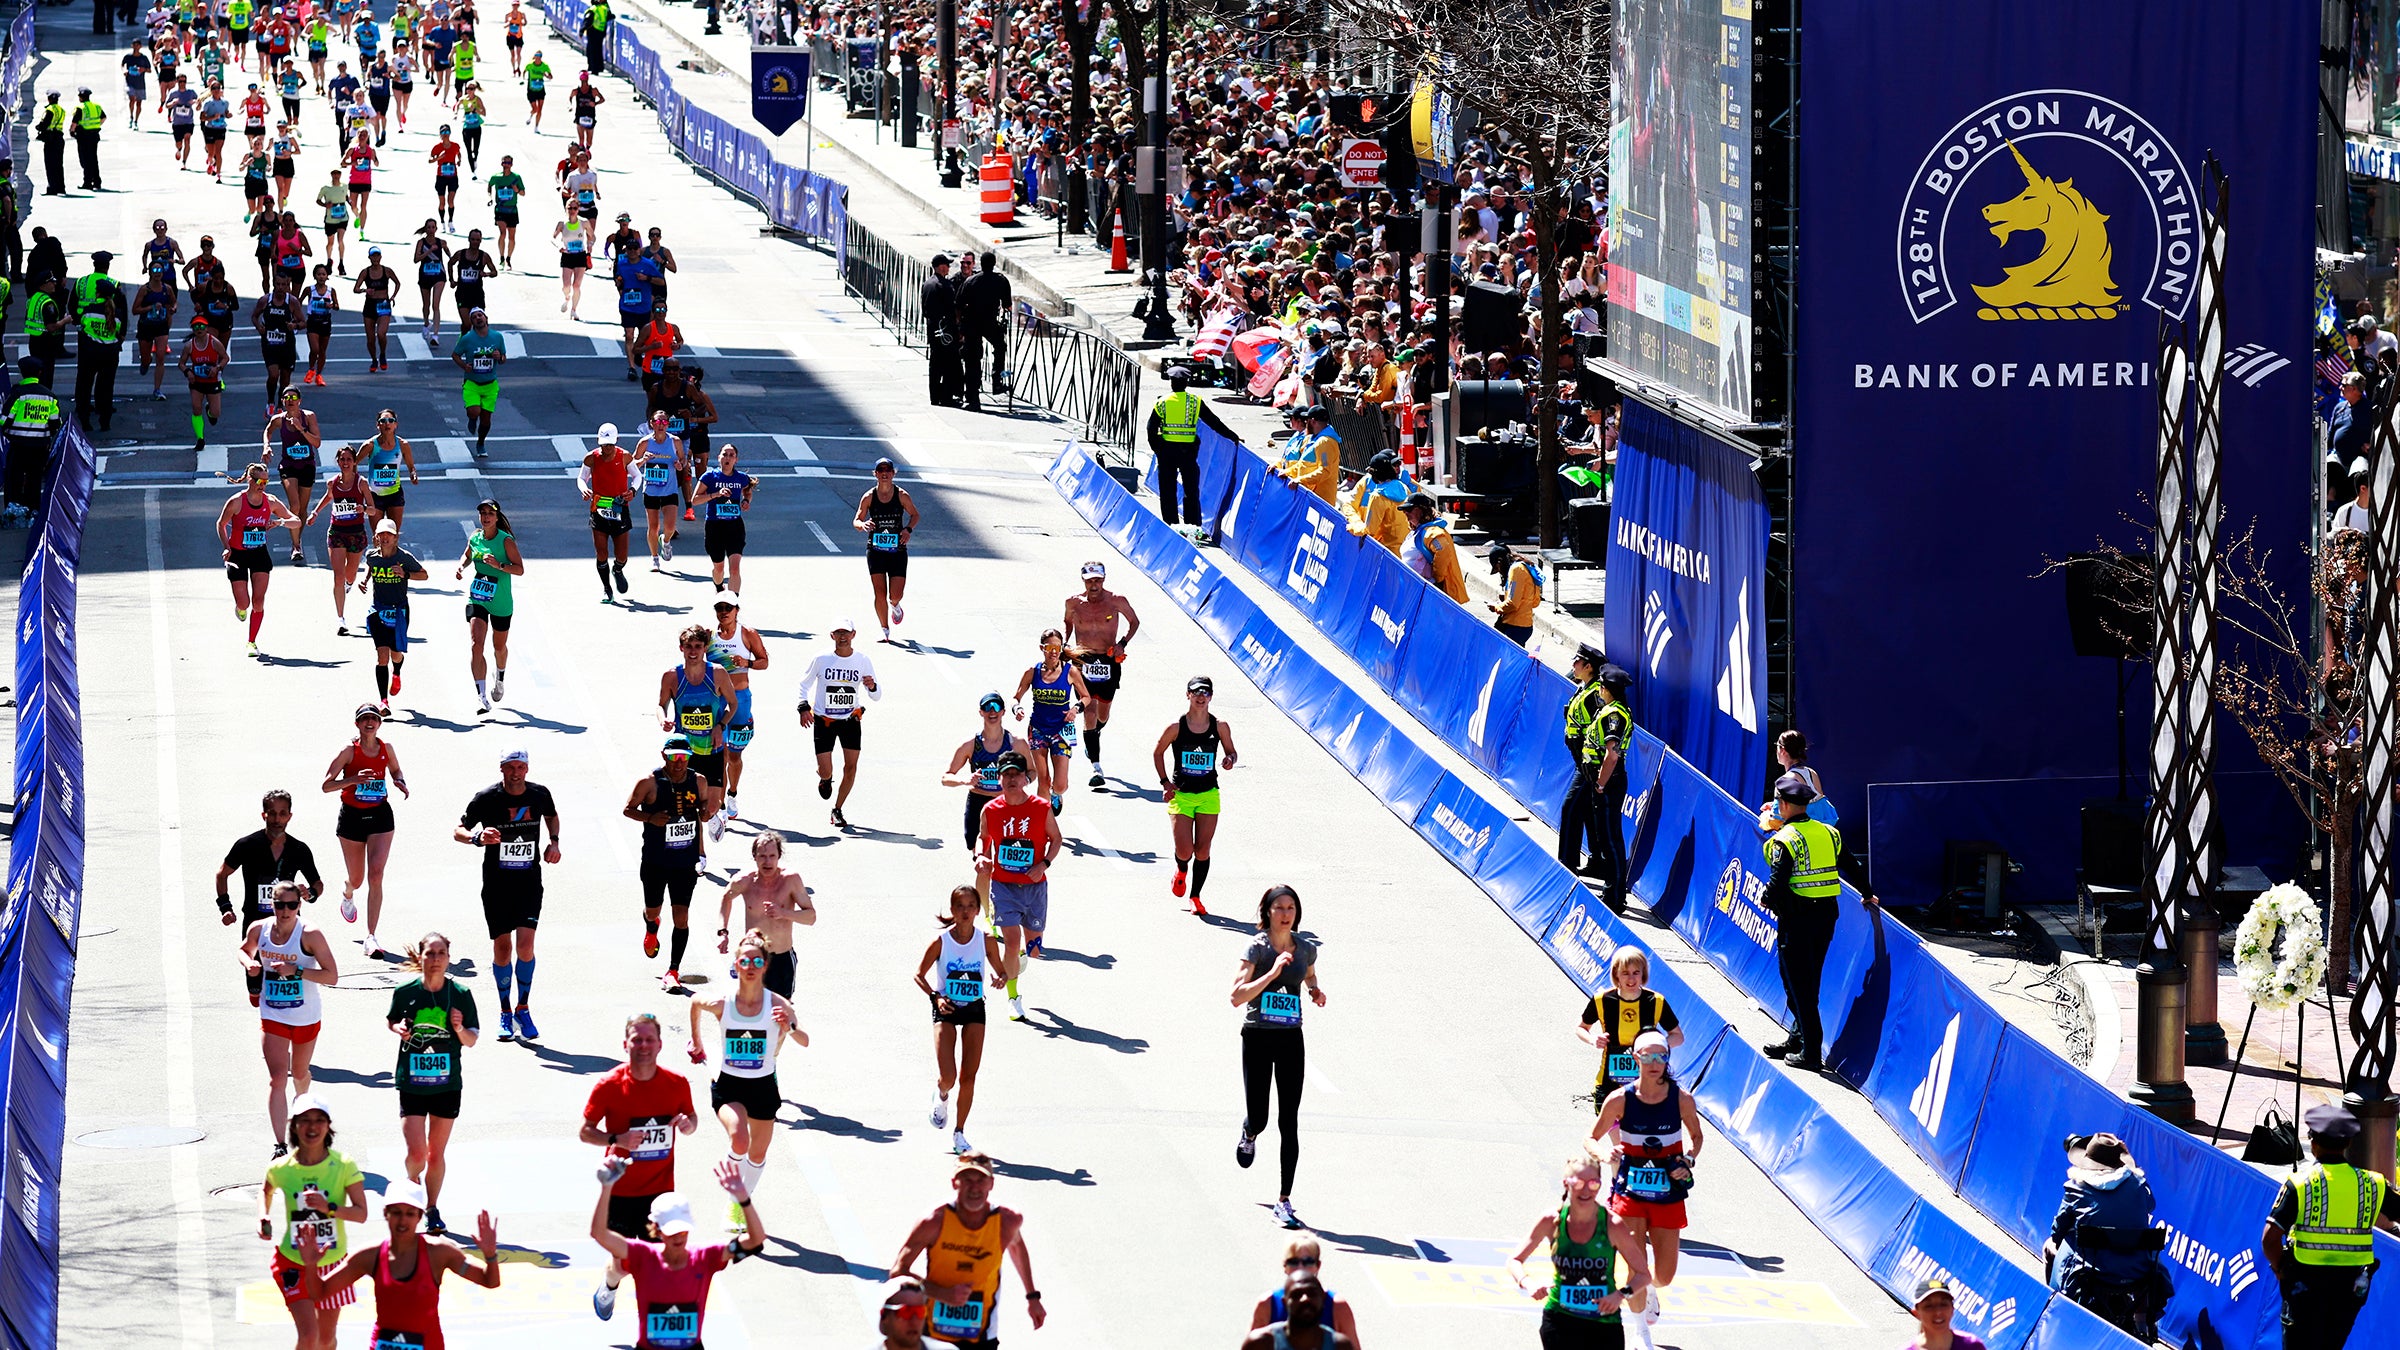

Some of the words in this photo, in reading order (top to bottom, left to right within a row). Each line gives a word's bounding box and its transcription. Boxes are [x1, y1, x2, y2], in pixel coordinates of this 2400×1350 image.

[1349, 151, 1362, 159] DO
[1364, 151, 1382, 159] NOT
[1909, 208, 1941, 305] 128TH
[1926, 101, 2059, 195] BOSTON
[2085, 105, 2192, 296] MARATHON
[269, 308, 285, 316] ROCK
[1855, 364, 1959, 388] BANK
[1971, 363, 2017, 388] OF
[2028, 363, 2197, 387] AMERIA
[24, 402, 49, 413] Boston
[24, 410, 49, 421] Police
[874, 534, 897, 545] 16972
[1617, 516, 1647, 555] BANK
[1655, 537, 1710, 584] AMERICA
[472, 580, 494, 593] 18704
[828, 694, 854, 706] 14800
[683, 715, 711, 727] 25935
[1184, 754, 1210, 766] 16951
[669, 824, 694, 837] 13584
[503, 844, 532, 858] 14276
[1002, 848, 1030, 862] 16922
[1731, 899, 1778, 953] MARATHON
[261, 950, 298, 962] BUFFALO
[268, 982, 300, 996] 17429
[949, 982, 979, 996] 17826
[1265, 995, 1297, 1011] 18524
[730, 1039, 764, 1054] 18188
[413, 1056, 447, 1070] 16346
[942, 1242, 983, 1253] saucony
[2168, 1230, 2225, 1287] AMERICA
[652, 1315, 692, 1331] 17601
